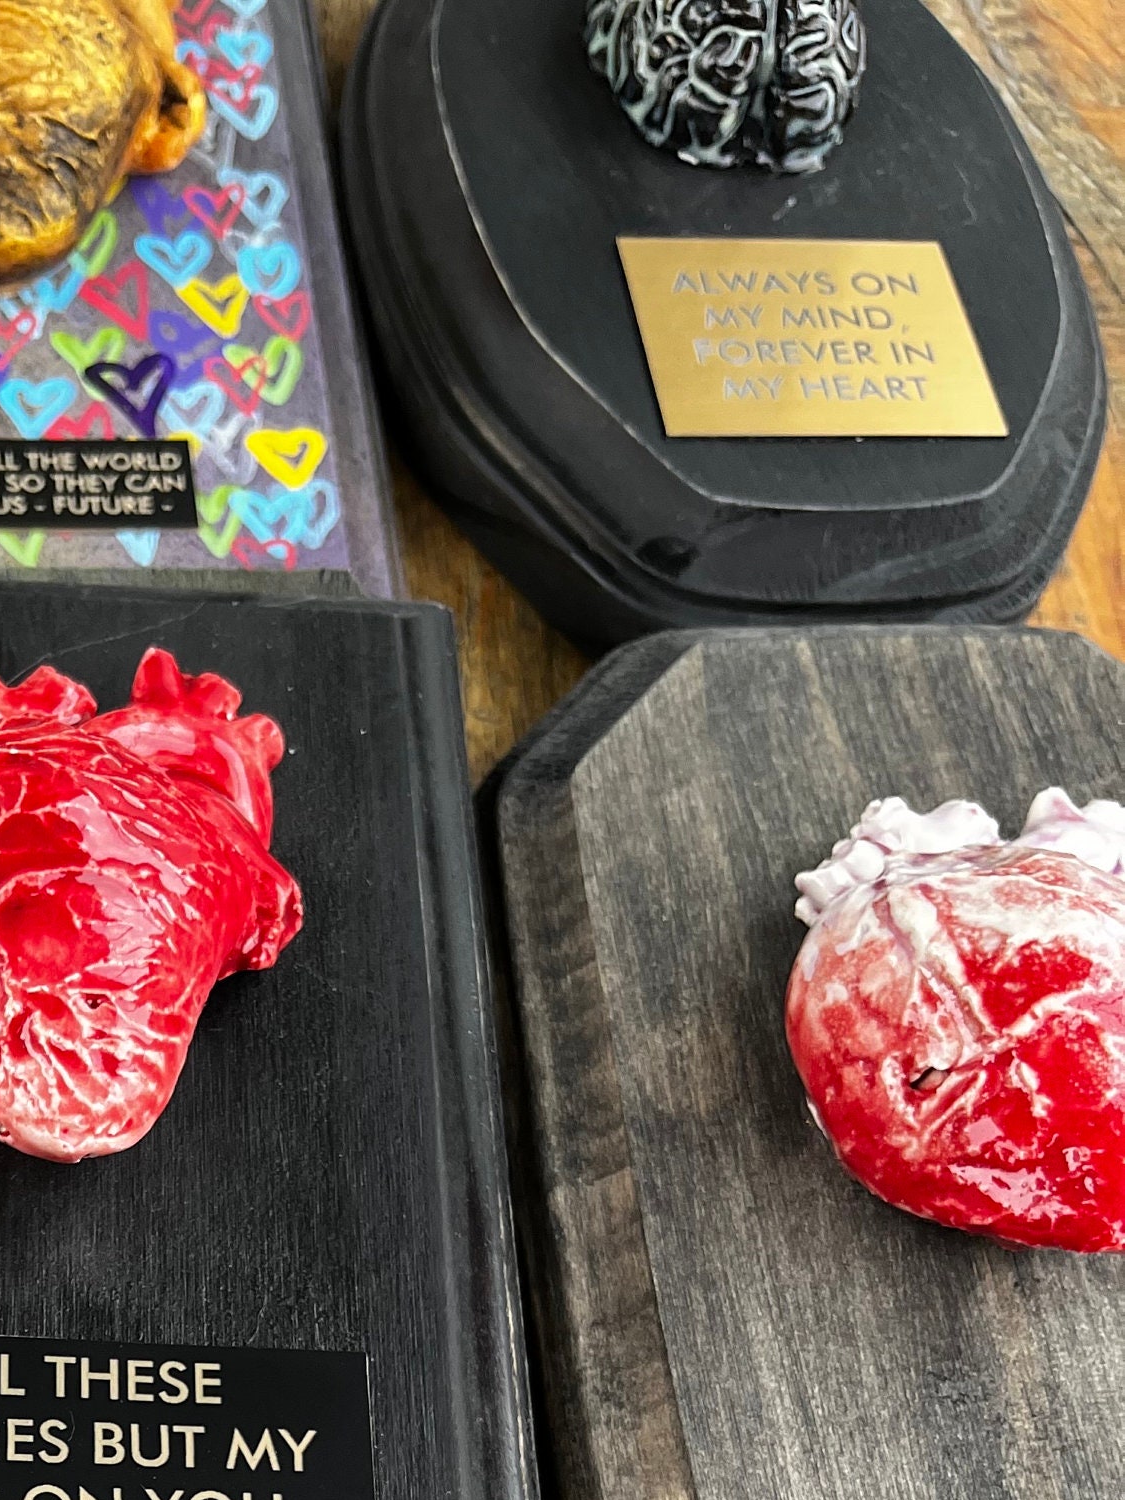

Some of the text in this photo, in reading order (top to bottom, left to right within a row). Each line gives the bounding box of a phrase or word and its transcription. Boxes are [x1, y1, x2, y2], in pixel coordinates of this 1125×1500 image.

[673, 271, 919, 296] ALWAYS ON
[705, 305, 763, 330] MY
[693, 338, 936, 366] FOREVER IN
[723, 375, 928, 401] MY HEART
[24, 452, 75, 471] THE
[81, 452, 181, 472] WORLD
[5, 474, 46, 493] SO
[51, 474, 119, 493] THEY
[124, 474, 186, 493] CAN
[54, 496, 154, 515] FUTURE
[44, 1355, 223, 1405] THESE
[93, 1422, 206, 1468] BUT
[226, 1428, 317, 1472] MY
